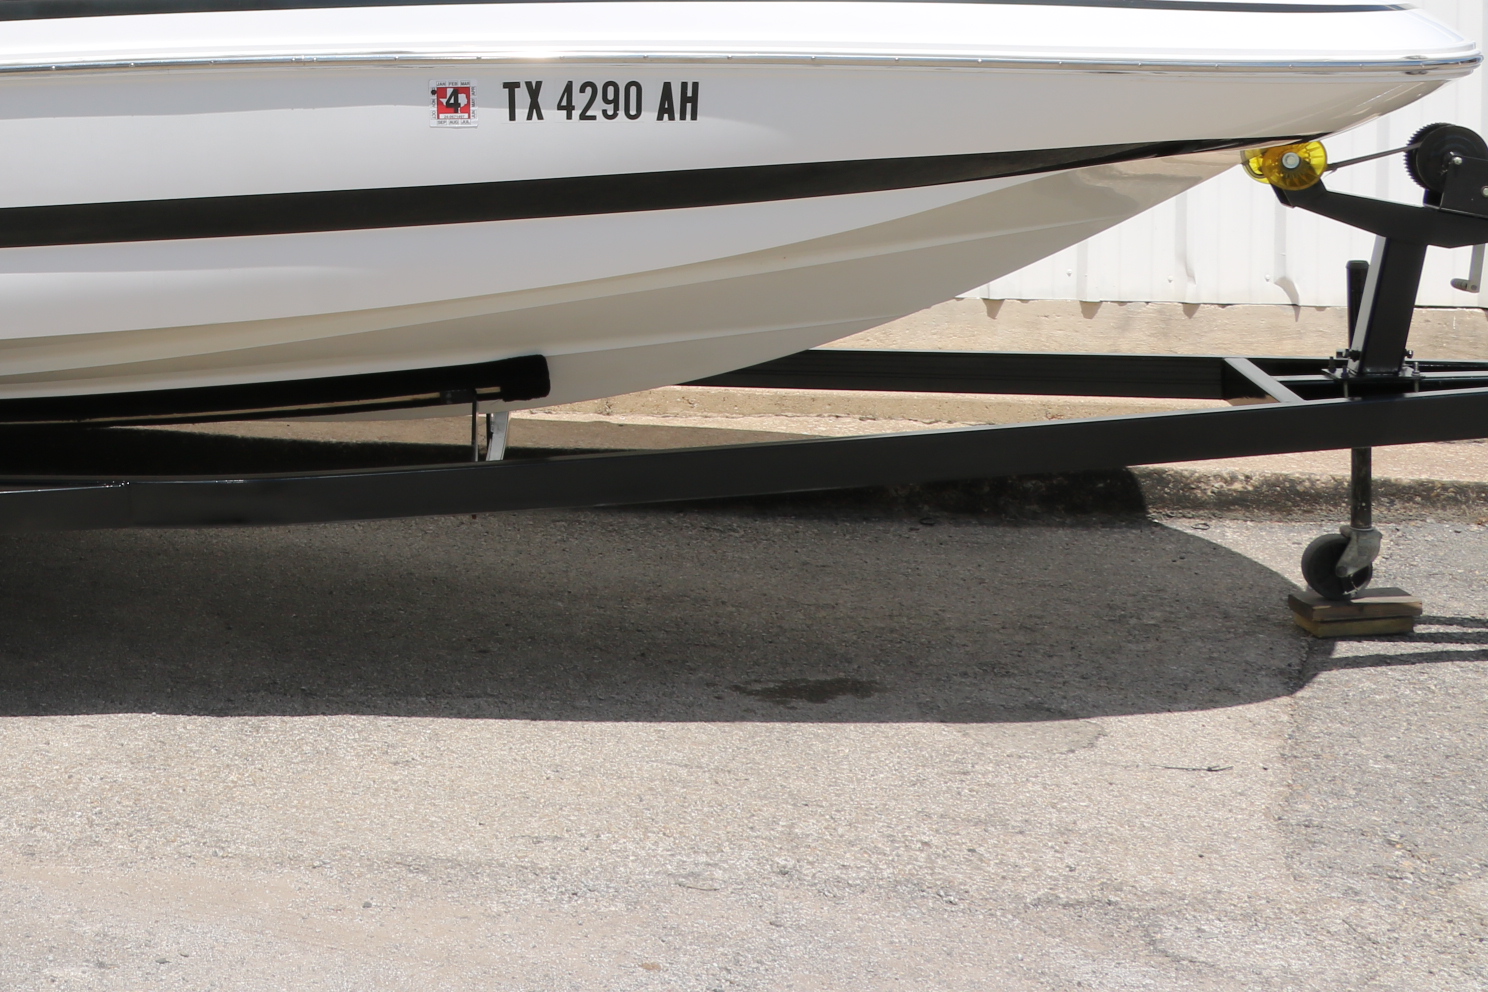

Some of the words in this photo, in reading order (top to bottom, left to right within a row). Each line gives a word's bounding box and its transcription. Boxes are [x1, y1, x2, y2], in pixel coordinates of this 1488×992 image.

[445, 89, 461, 114] 4
[502, 80, 544, 122] TX
[556, 80, 643, 121] 4290
[656, 81, 700, 121] AH
